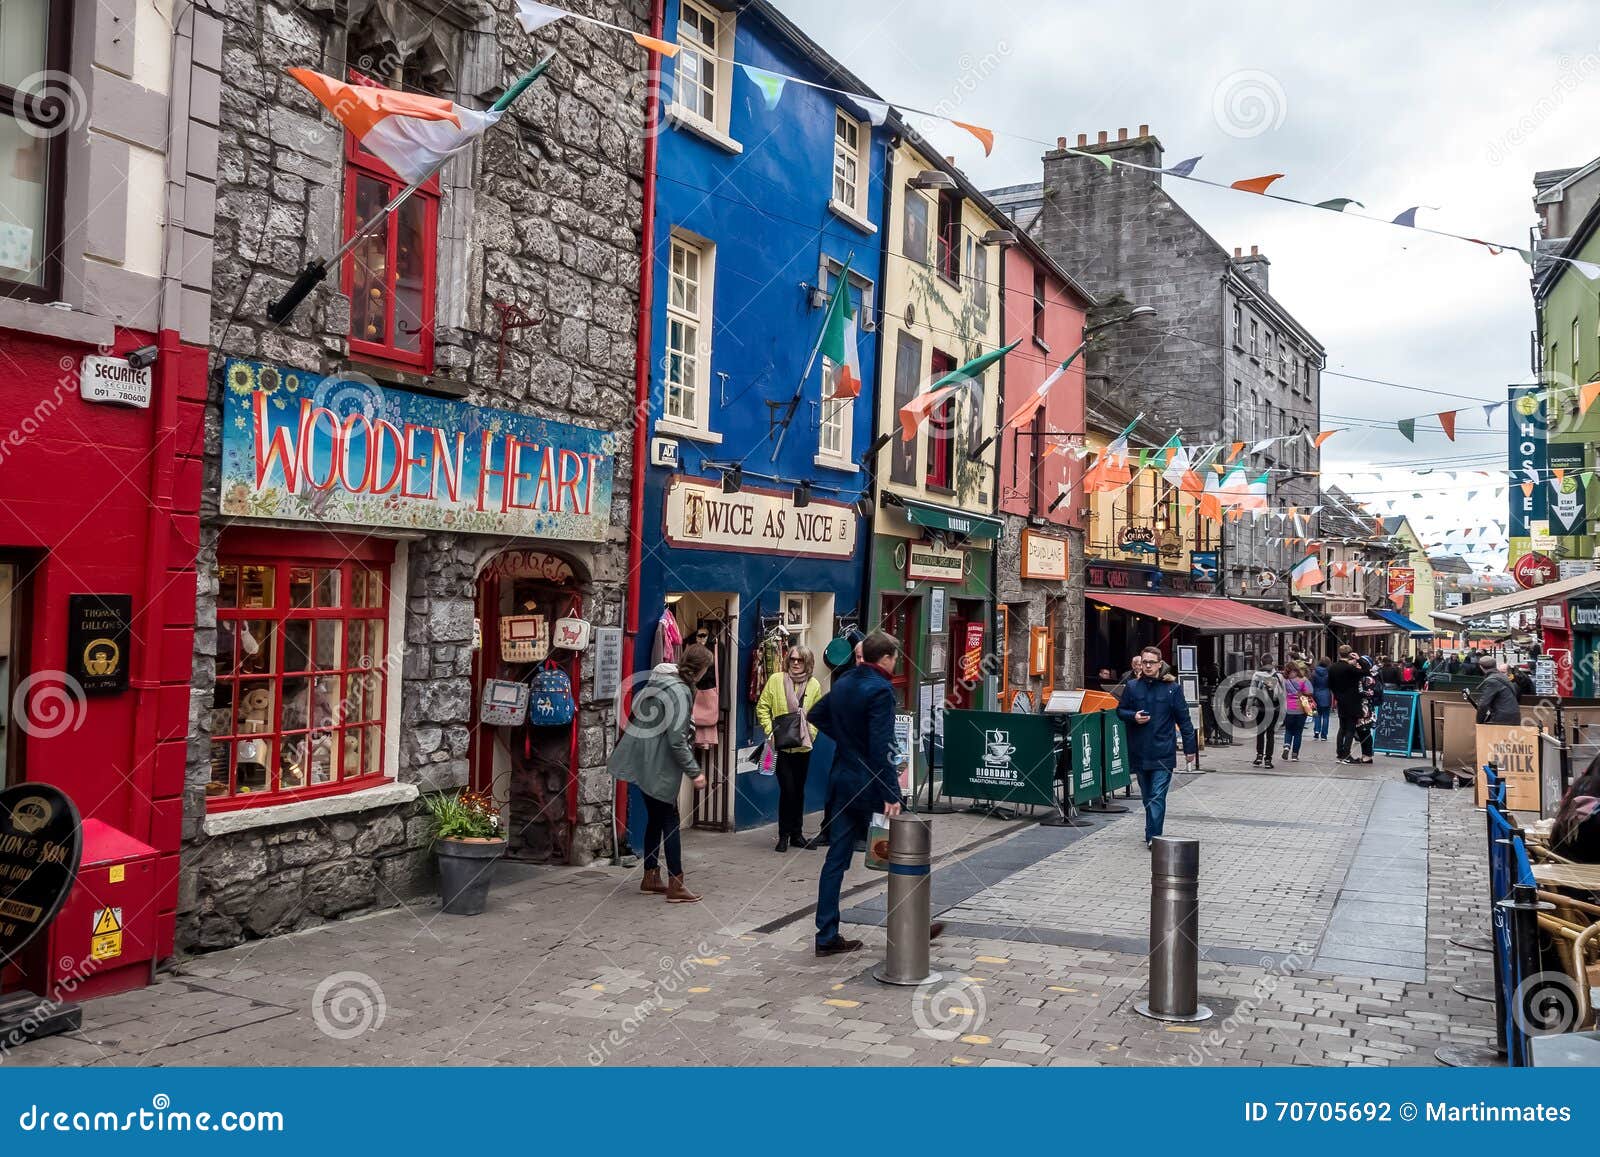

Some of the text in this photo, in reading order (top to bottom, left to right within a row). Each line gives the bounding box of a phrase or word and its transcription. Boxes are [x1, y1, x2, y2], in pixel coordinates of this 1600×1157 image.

[95, 363, 147, 386] SECURITEC
[103, 381, 148, 394] SECURITY
[94, 388, 109, 398] 091
[118, 391, 147, 403] 780600
[252, 389, 605, 516] WOODEN HEART
[663, 445, 676, 458] ADT
[1520, 422, 1536, 531] HOSEL
[686, 493, 754, 538] TWICE
[762, 508, 786, 539] AS
[794, 512, 833, 543] NICE
[1106, 569, 1129, 589] QUAYS
[83, 608, 121, 618] THOMAS
[1493, 743, 1535, 755] ORGANIC
[1494, 754, 1535, 774] MILK
[976, 767, 1018, 779] RIORDAN'S
[969, 777, 998, 785] TRADITIONAL
